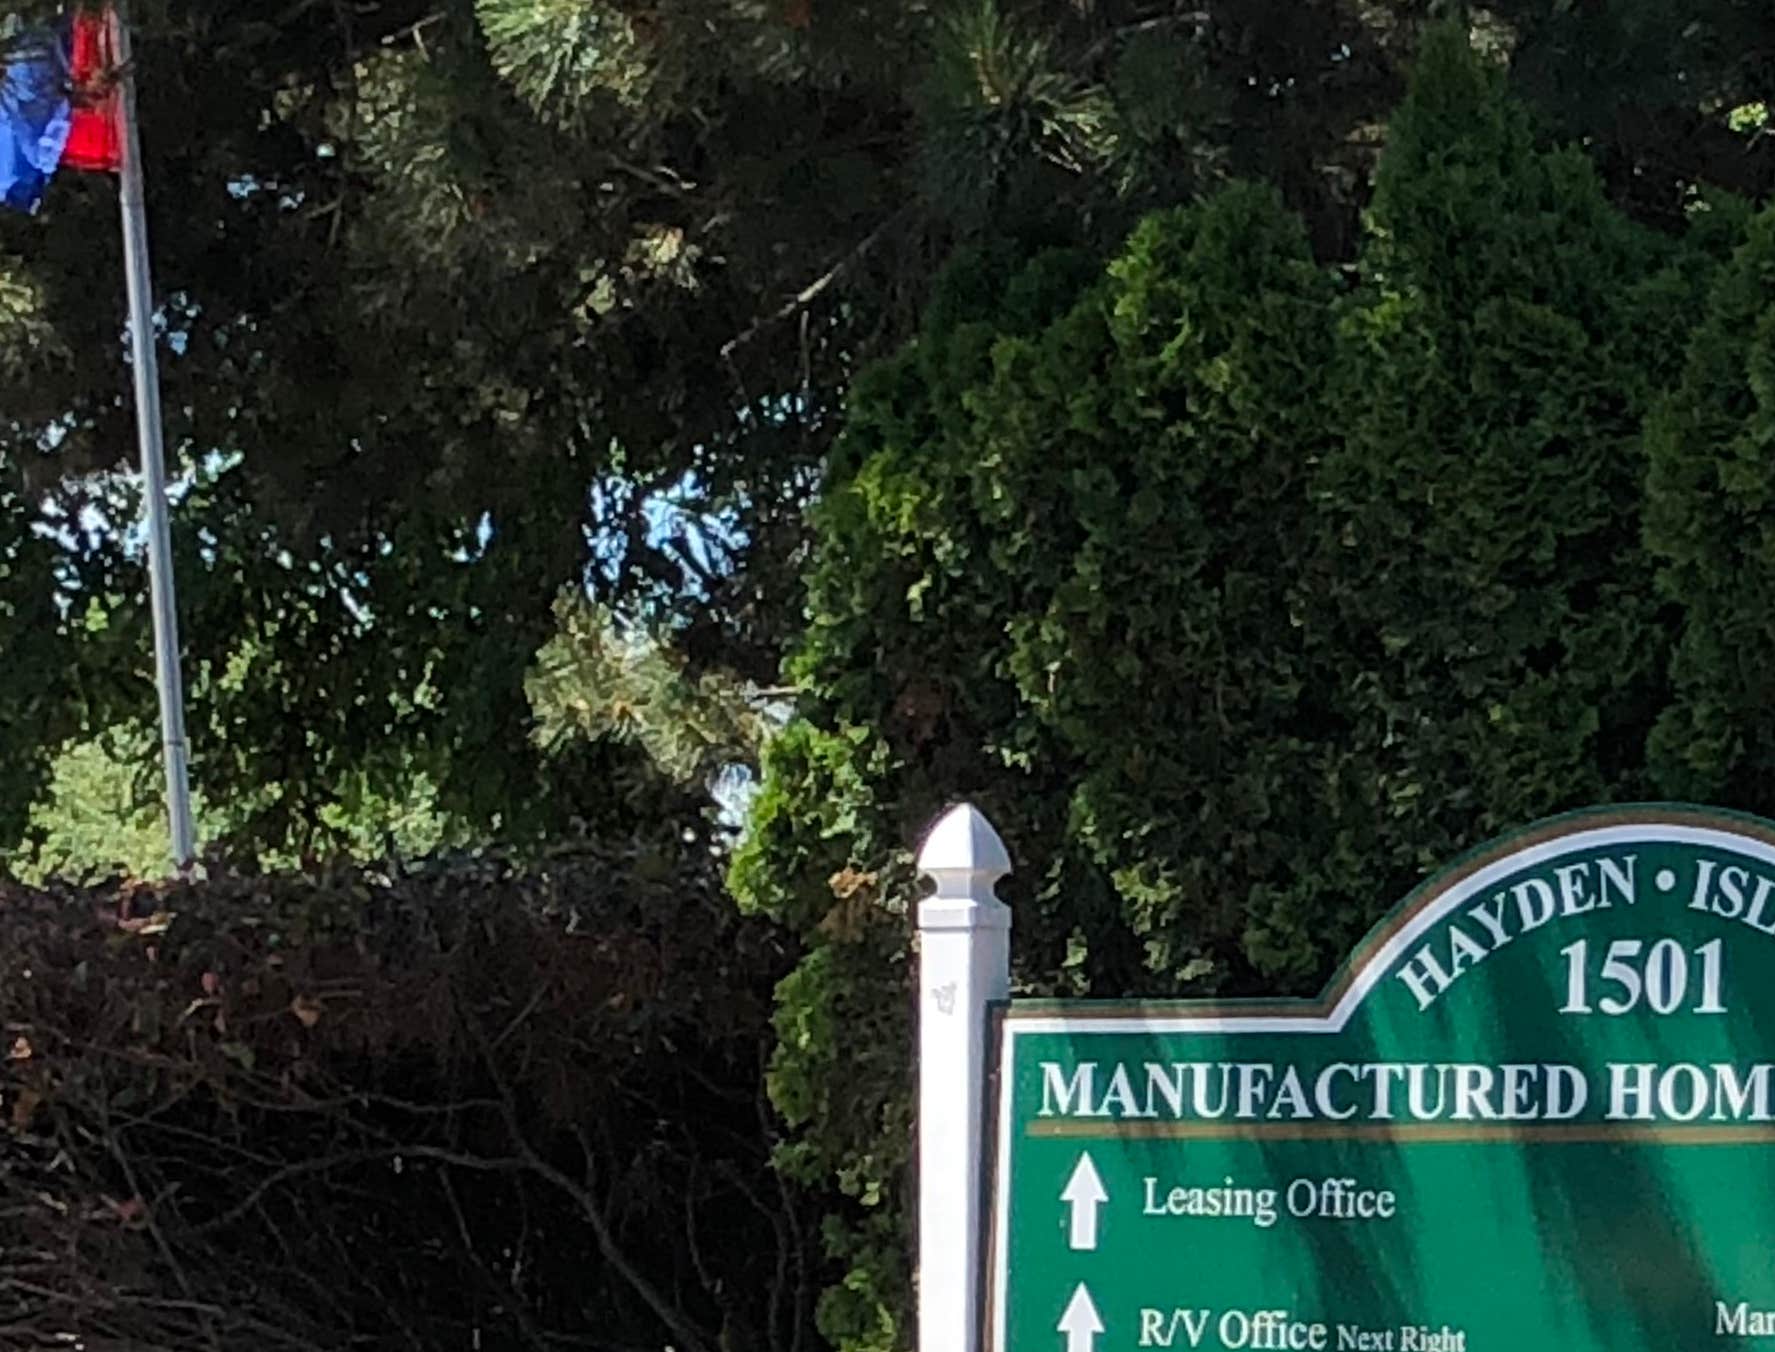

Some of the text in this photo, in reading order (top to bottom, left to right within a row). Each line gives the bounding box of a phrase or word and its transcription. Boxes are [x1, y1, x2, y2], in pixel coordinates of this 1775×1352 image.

[1396, 855, 1638, 1012] HAYDEN
[1557, 938, 1728, 1015] 1501
[1038, 1062, 1587, 1120] MANUFACTURED
[1142, 1177, 1395, 1227] Leasing Office
[1139, 1308, 1209, 1348] R/V
[1218, 1308, 1327, 1350] Office
[1336, 1323, 1394, 1352] Next
